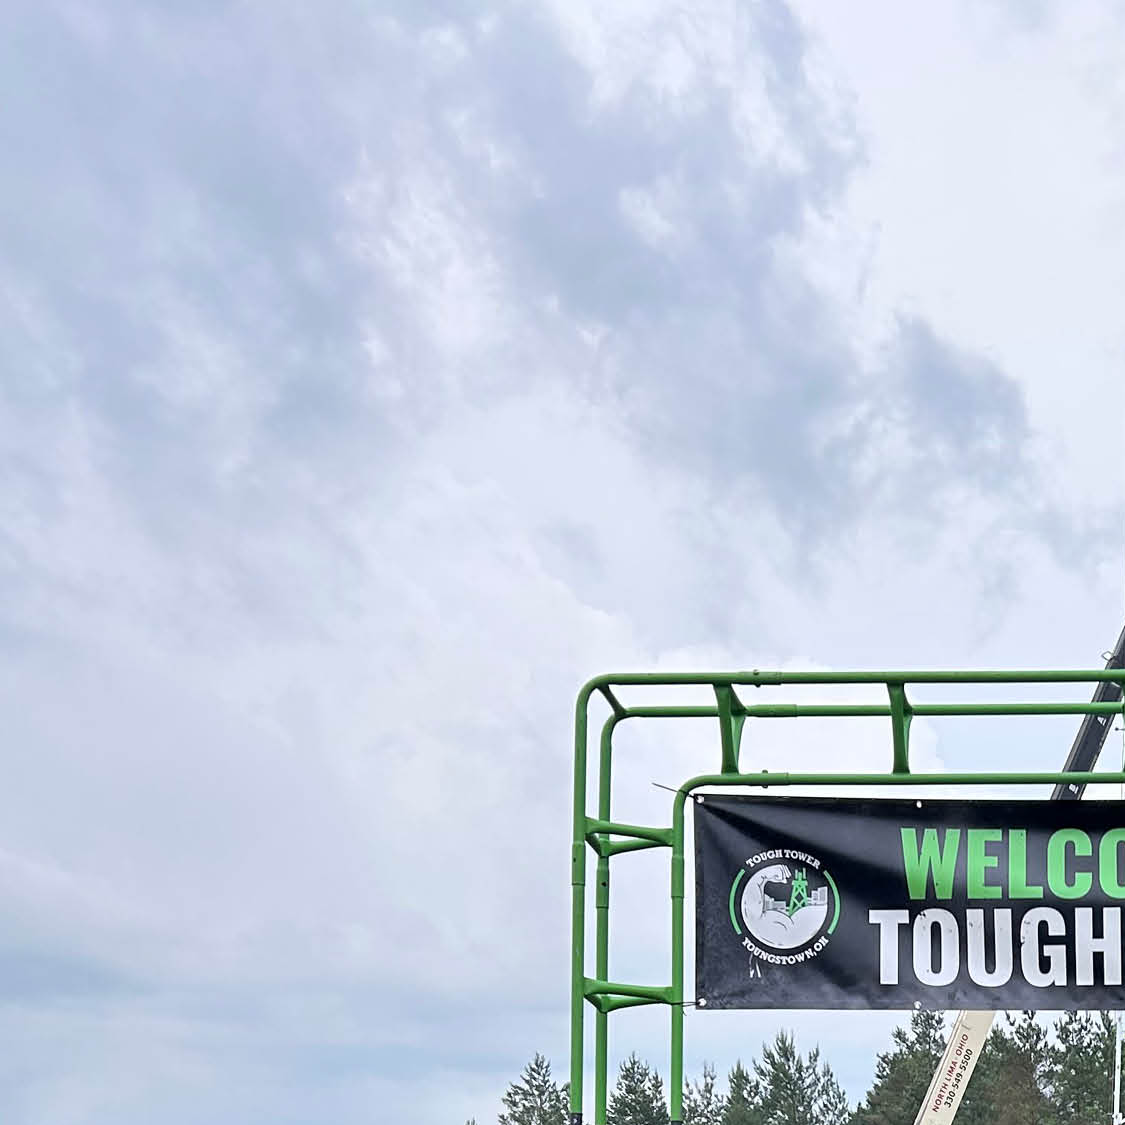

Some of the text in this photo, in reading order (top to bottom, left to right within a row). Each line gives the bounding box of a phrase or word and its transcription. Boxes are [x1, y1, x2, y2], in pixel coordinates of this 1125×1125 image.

[746, 849, 821, 870] TOUGH TOWER
[868, 906, 1123, 988] TOUGH
[932, 1034, 969, 1112] NORTH LIMA OHIO
[944, 1048, 973, 1108] 330-549-5500
